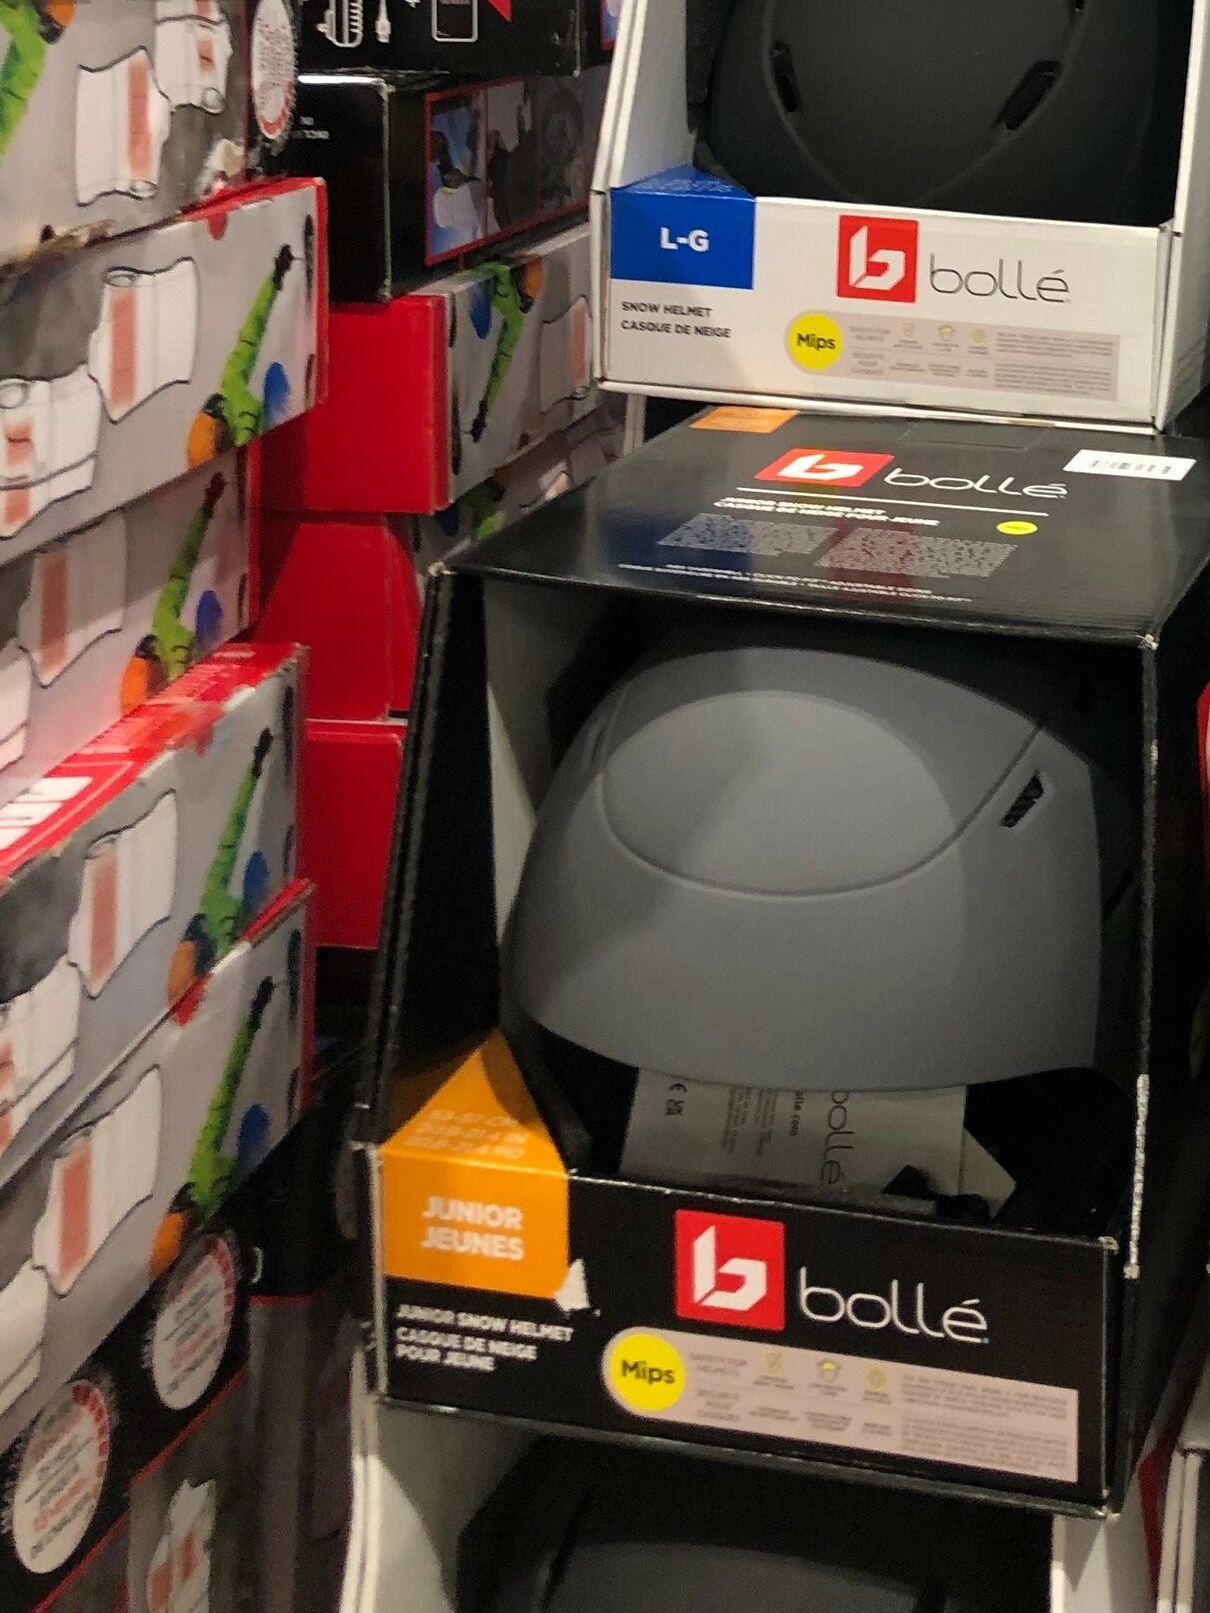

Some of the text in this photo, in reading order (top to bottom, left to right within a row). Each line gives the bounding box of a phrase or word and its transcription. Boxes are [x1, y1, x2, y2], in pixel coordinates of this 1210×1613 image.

[660, 227, 709, 252] L-G
[930, 253, 1071, 303] bollé
[621, 301, 713, 318] SNOW HELMET
[621, 319, 731, 338] CASQUE DE NEIGE
[797, 331, 836, 350] Mips
[884, 467, 1067, 498] bollé
[422, 1196, 524, 1231] JUNIOR
[421, 1226, 525, 1261] JEUNES
[799, 1265, 988, 1345] bollé
[620, 1360, 675, 1386] Mips
